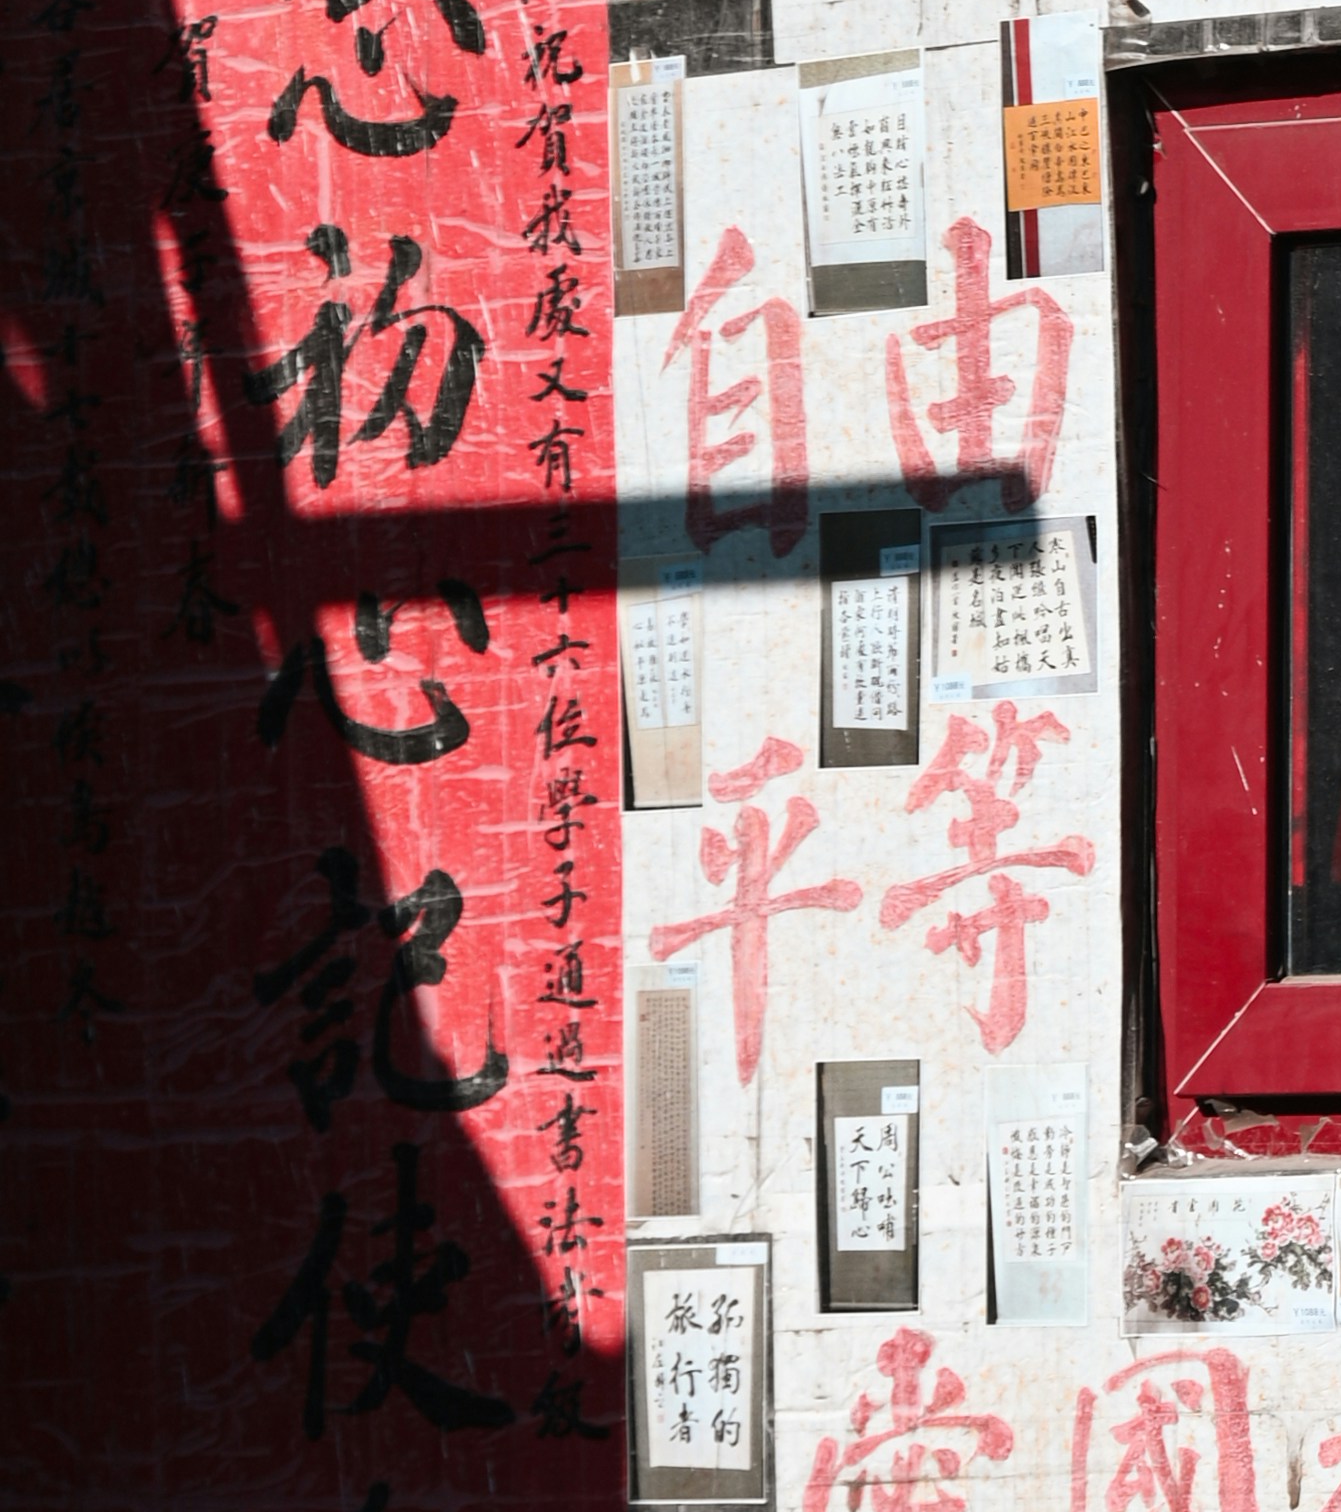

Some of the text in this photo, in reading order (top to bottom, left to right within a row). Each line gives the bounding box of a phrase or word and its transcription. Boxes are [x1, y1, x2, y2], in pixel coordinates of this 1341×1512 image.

[663, 216, 1075, 559] 自由
[648, 700, 1097, 1086] 平等
[664, 1291, 704, 1445] 旅行者
[706, 1292, 745, 1448] 孤獨的
